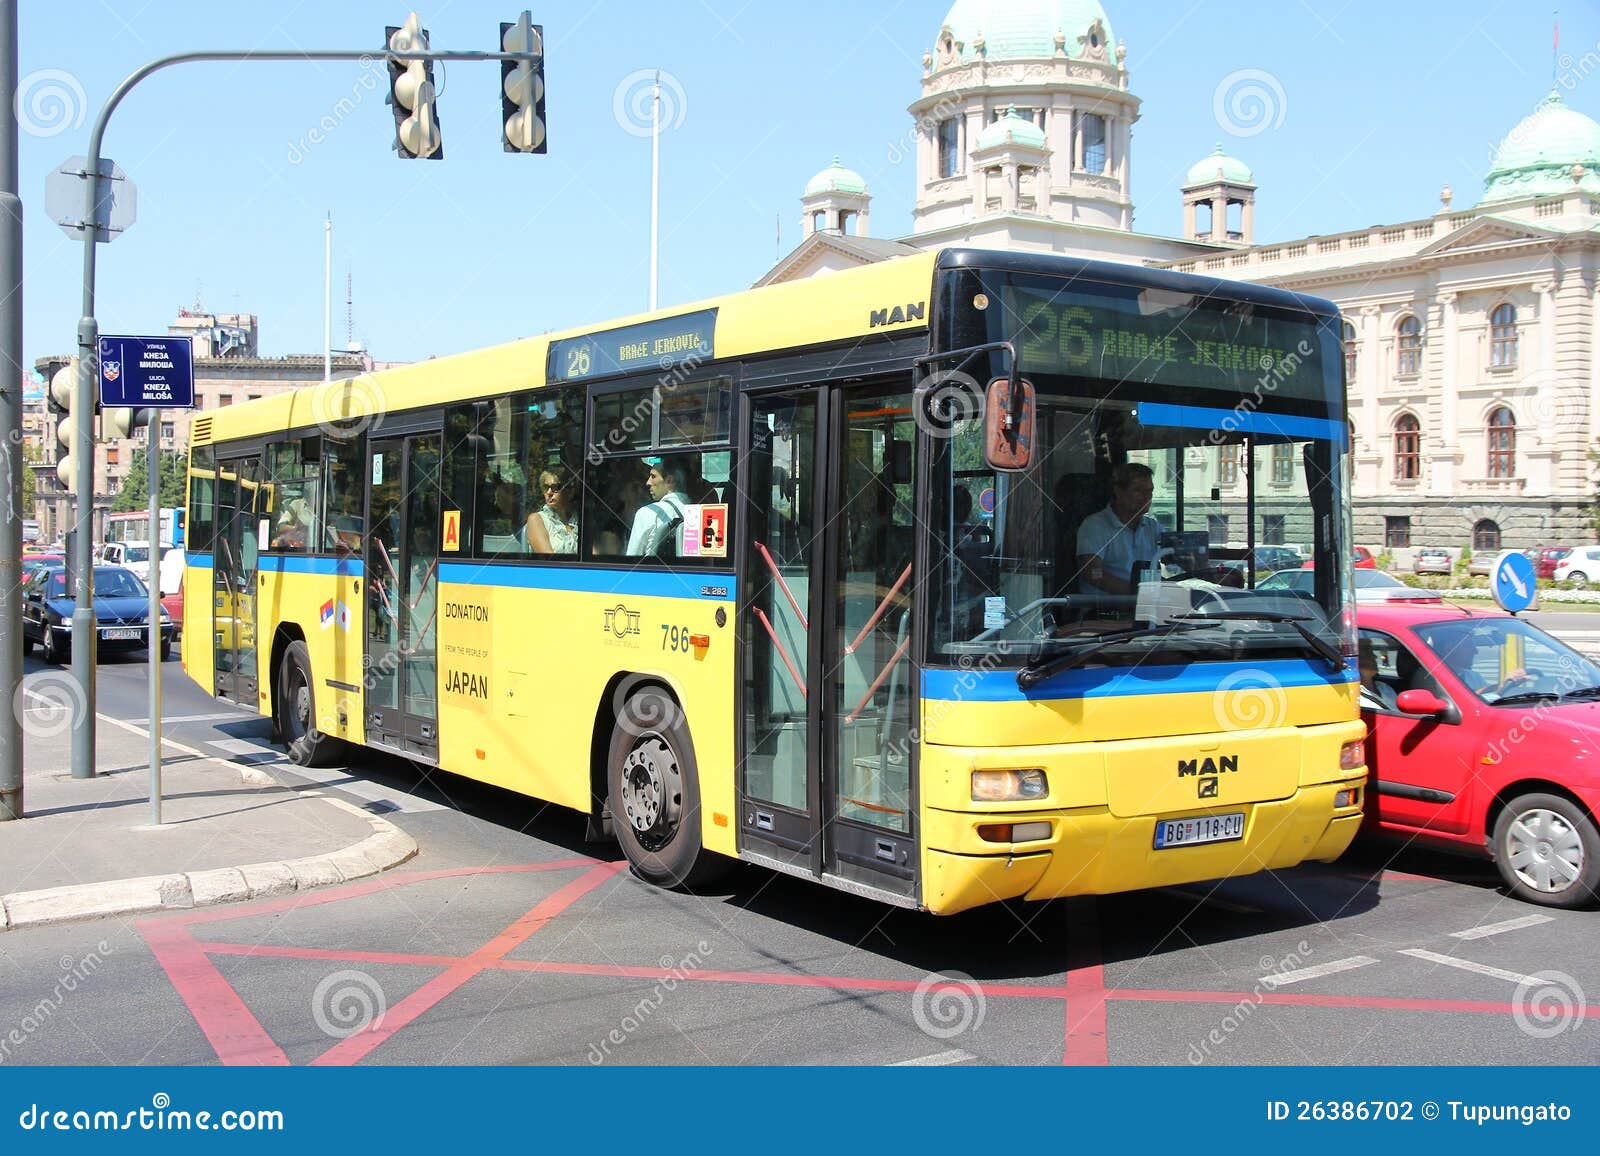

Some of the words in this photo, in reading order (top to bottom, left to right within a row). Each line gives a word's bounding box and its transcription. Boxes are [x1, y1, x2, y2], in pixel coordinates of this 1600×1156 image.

[870, 301, 925, 328] MAN
[1022, 300, 1095, 368] 26
[139, 361, 174, 369] МИЛОША
[143, 352, 169, 360] КНЕЗА
[567, 345, 590, 377] 26
[142, 391, 173, 400] MILOŠA
[144, 383, 171, 391] KNEZA
[446, 516, 457, 544] A
[701, 586, 711, 595] SL
[712, 586, 727, 596] 283
[445, 602, 488, 622] DONATION
[661, 624, 689, 653] 796
[445, 669, 488, 700] JAPAN
[1178, 754, 1238, 777] MAN
[1166, 823, 1185, 843] BG
